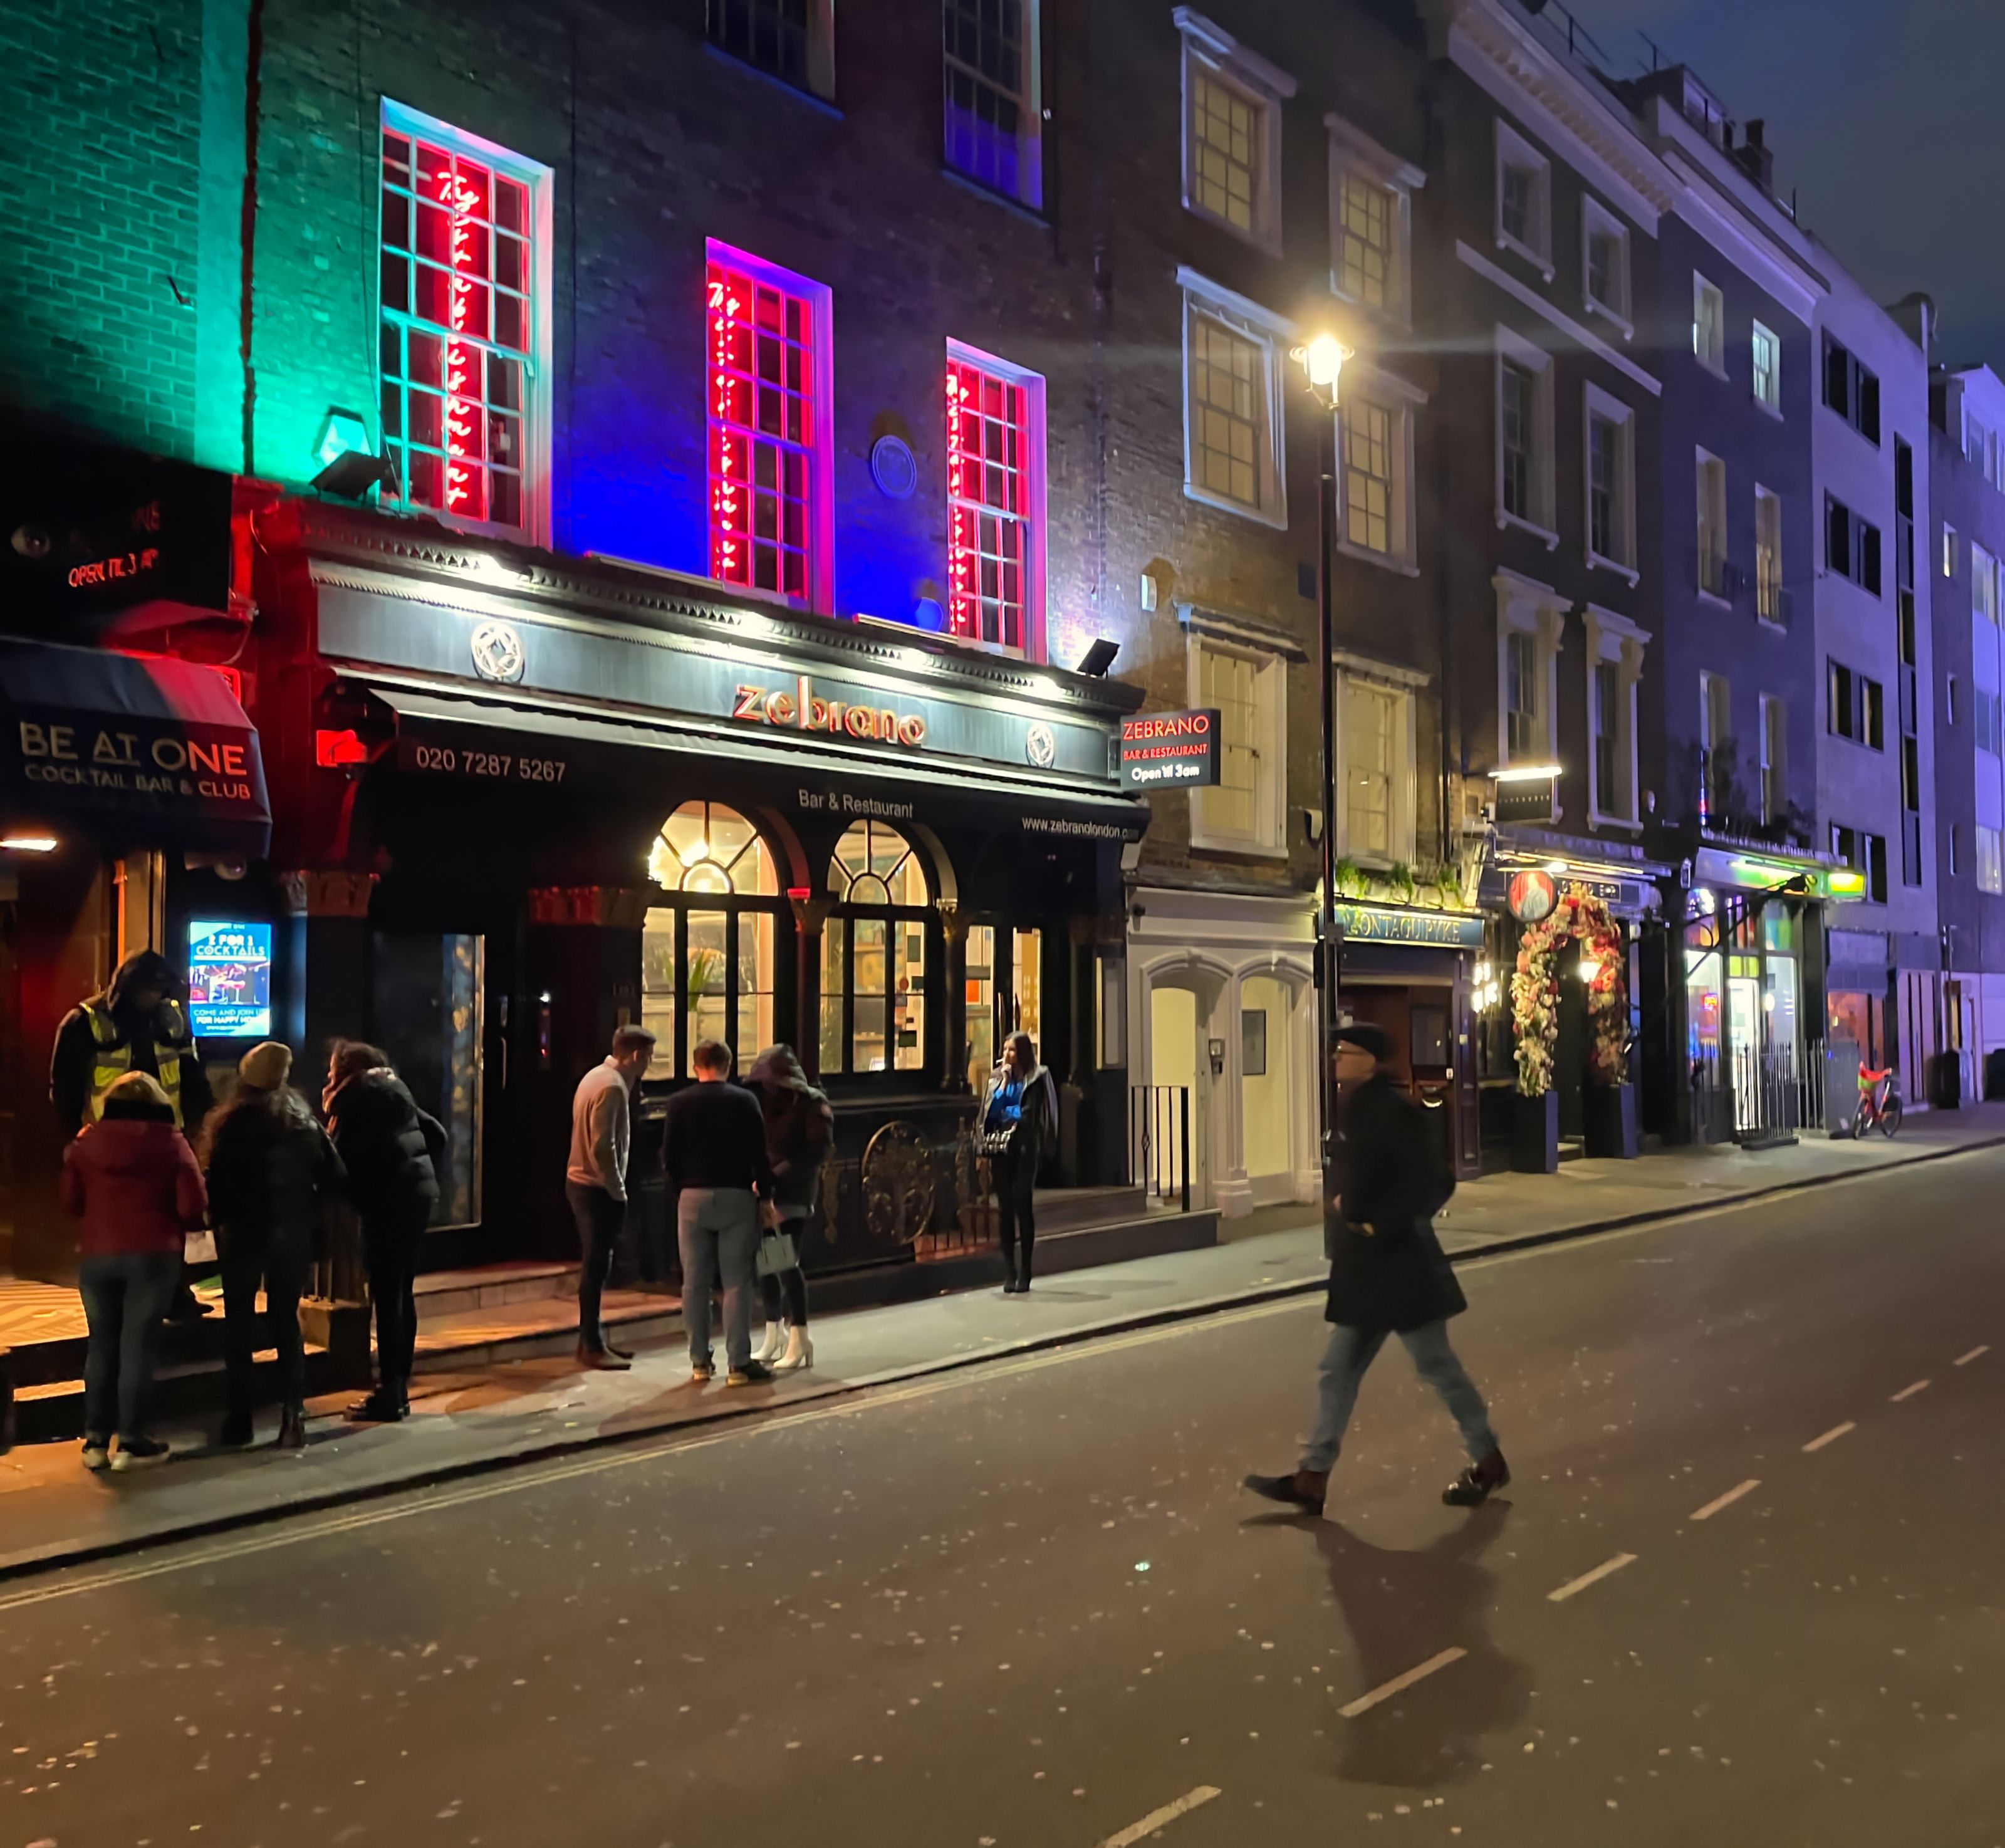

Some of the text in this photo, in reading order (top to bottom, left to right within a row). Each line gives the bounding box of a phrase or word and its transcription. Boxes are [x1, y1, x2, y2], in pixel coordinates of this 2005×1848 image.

[734, 676, 927, 746] zebrano
[1123, 715, 1209, 740] ZEBRANO
[20, 721, 248, 776] BE AT ONE
[1123, 749, 1140, 760] BAR
[1150, 743, 1207, 758] RESTAURANT
[416, 746, 566, 783] 020 7287 5267
[1132, 767, 1162, 783] Open
[1175, 764, 1200, 777] 3am
[24, 763, 129, 790] COCKTAIL
[135, 773, 175, 793] BAR
[197, 780, 251, 800] CLUB
[799, 789, 914, 818] Bar & Restaurant
[1022, 817, 1139, 840] www.zebranolondon.c
[196, 945, 265, 956] COCKTAILS
